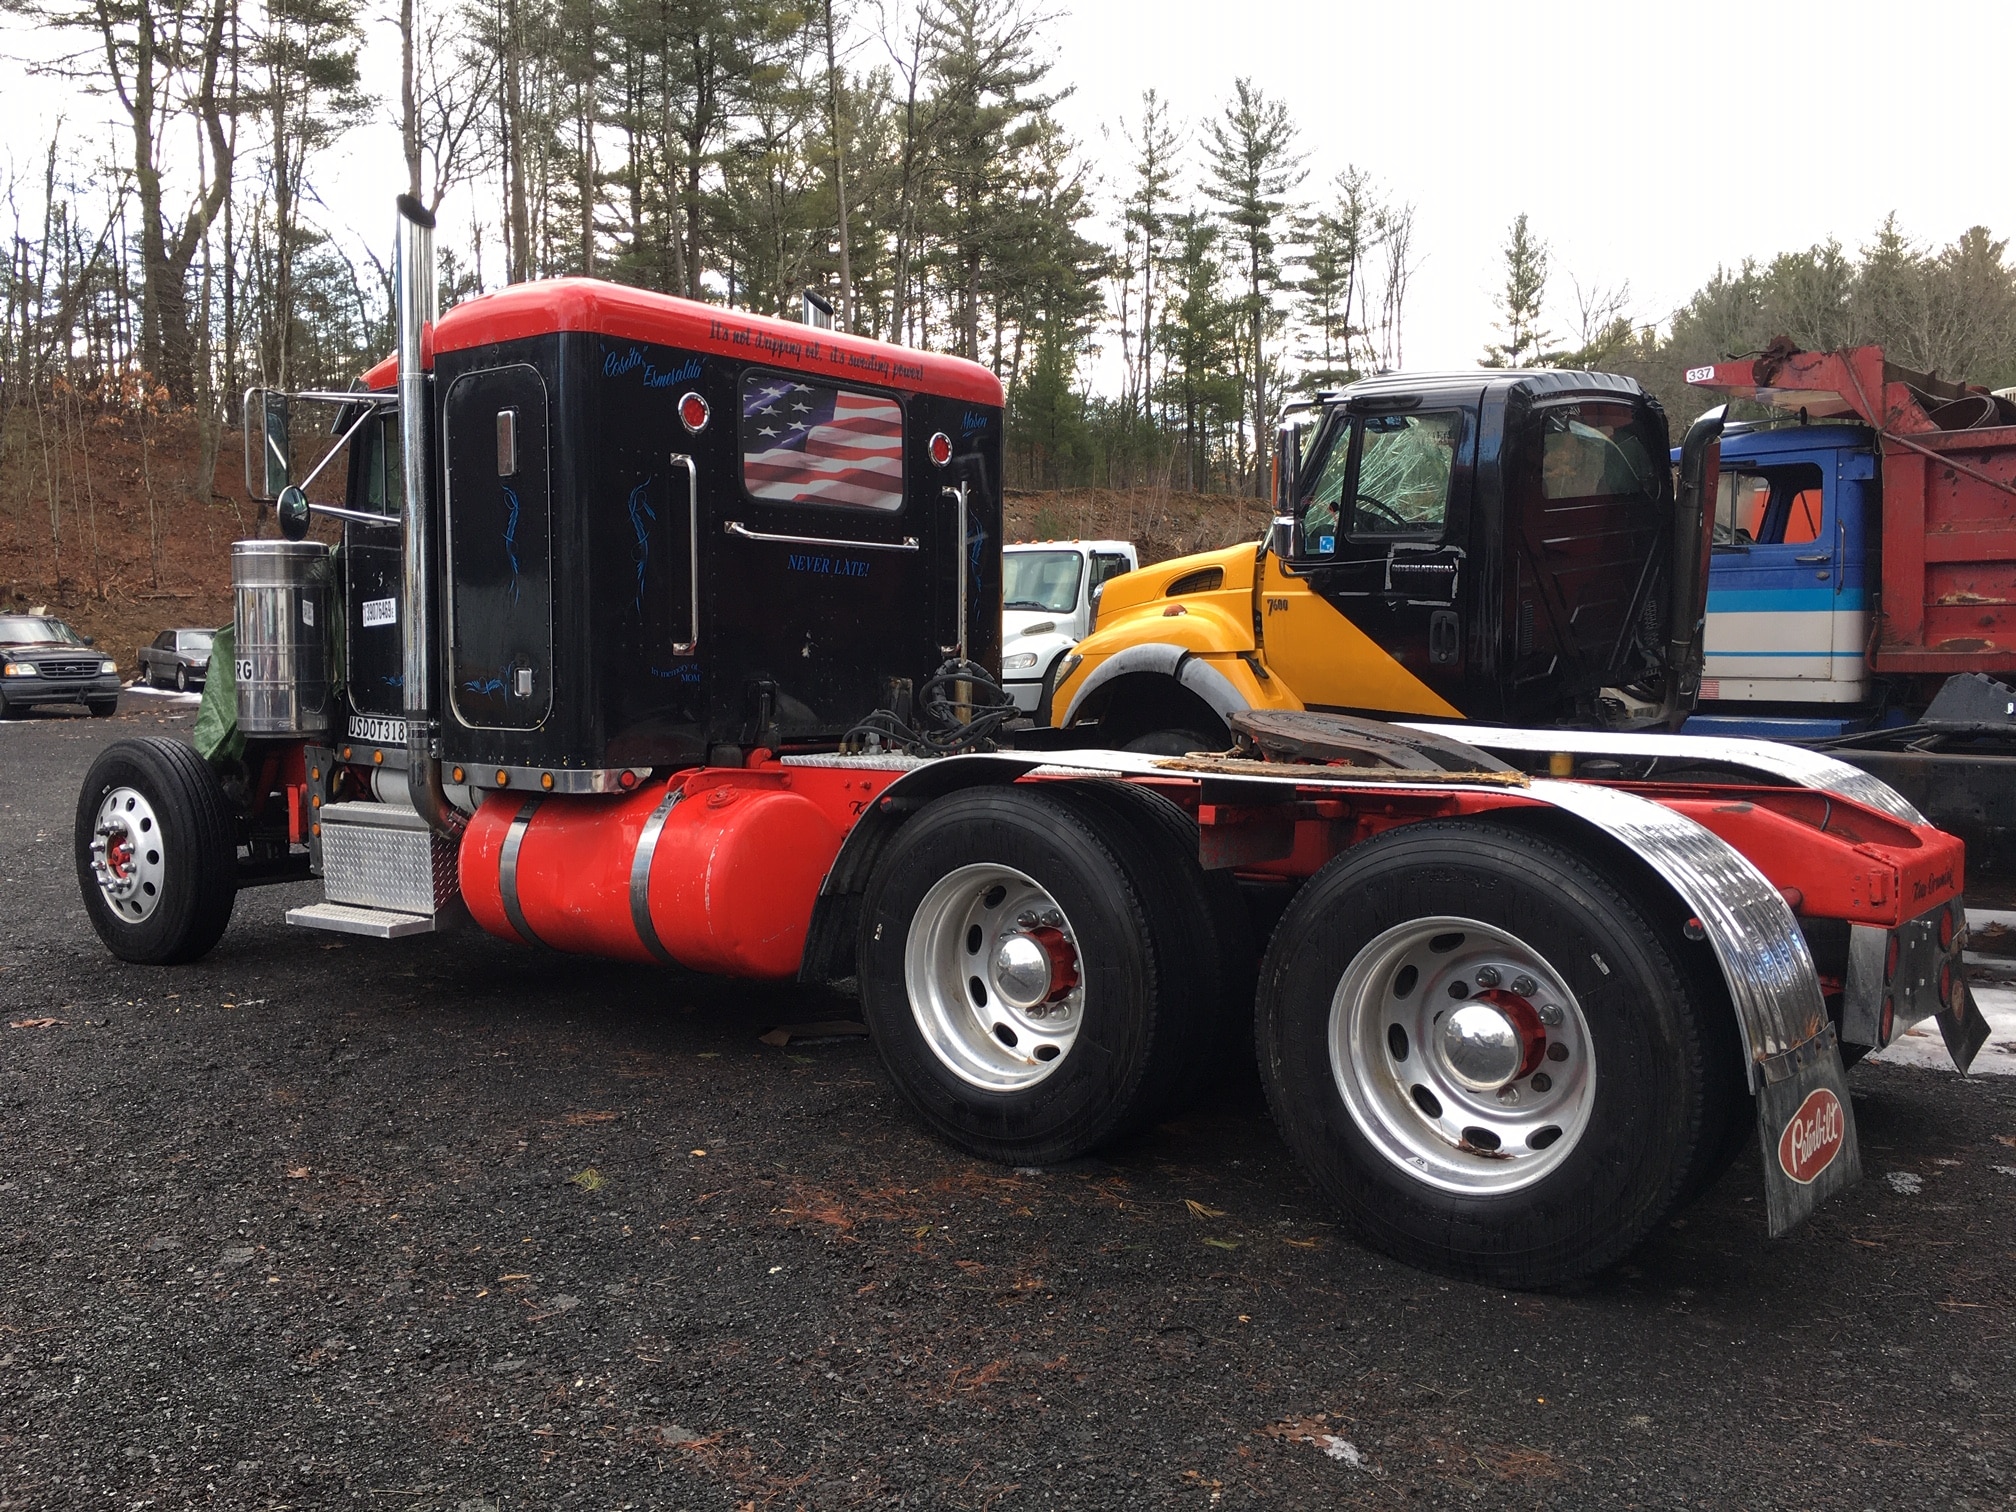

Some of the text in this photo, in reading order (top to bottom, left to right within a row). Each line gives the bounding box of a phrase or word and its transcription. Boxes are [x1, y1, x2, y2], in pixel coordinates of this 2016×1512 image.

[733, 327, 751, 346] not
[755, 330, 802, 362] dripping
[848, 353, 889, 379] sweating
[1689, 368, 1711, 380] 337
[787, 554, 870, 577] NEVER LATE!
[1266, 599, 1288, 616] 7600
[1791, 1102, 1838, 1174] Peterbilt
